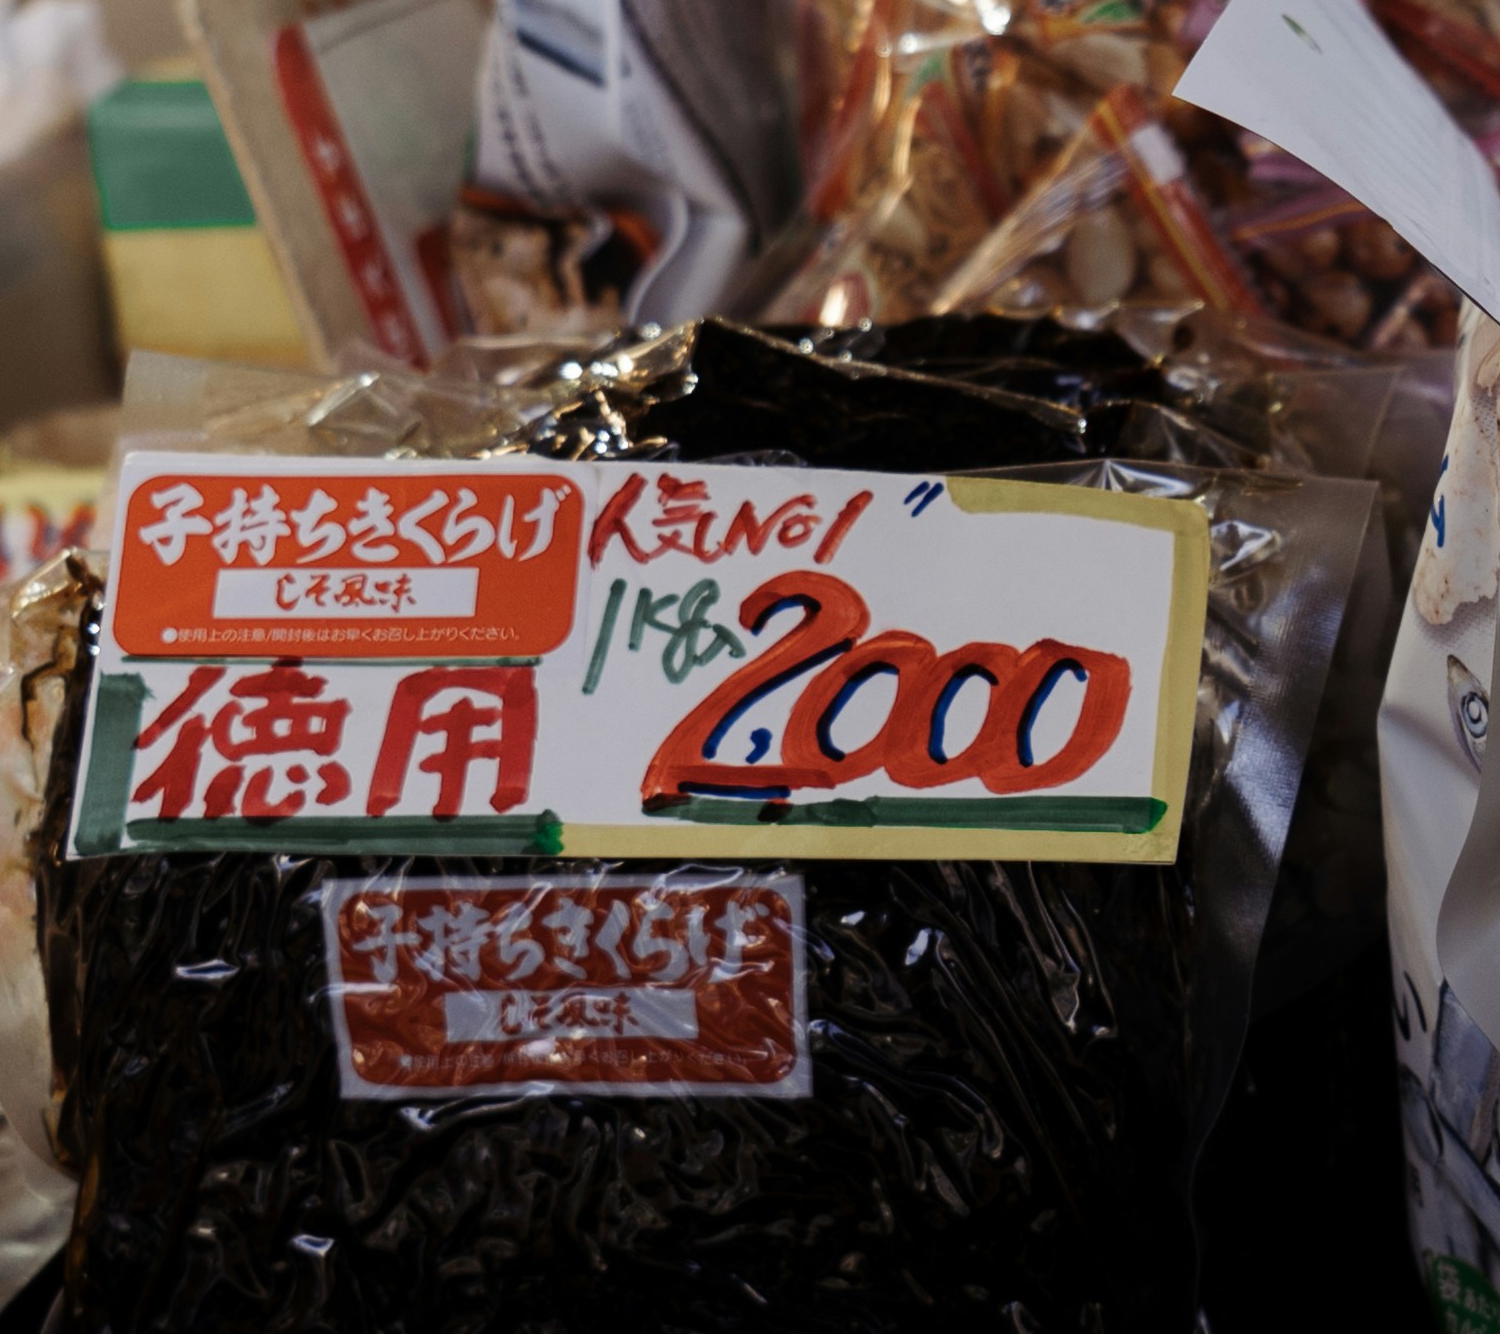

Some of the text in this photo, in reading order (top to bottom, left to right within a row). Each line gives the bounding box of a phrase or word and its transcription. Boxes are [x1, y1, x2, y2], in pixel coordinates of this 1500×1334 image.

[138, 482, 573, 567] 子持ちきくらげ
[275, 572, 418, 614] しそ風味
[130, 655, 540, 825] 徳用
[352, 895, 770, 985] 子持ちきくらげ
